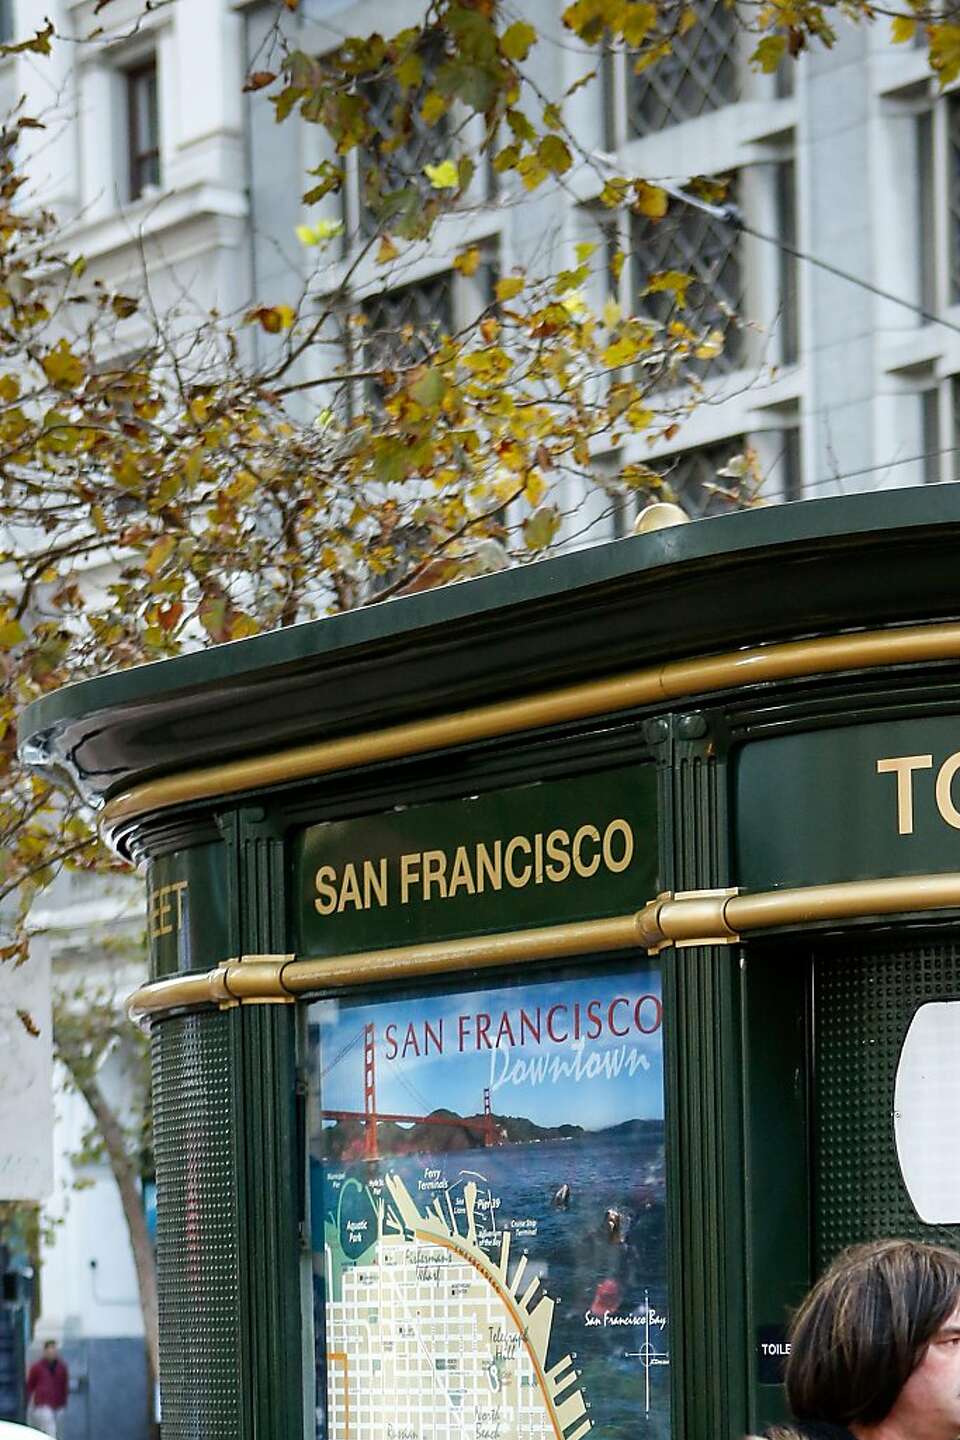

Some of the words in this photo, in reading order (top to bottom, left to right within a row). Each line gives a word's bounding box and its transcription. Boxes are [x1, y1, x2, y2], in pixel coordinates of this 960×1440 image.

[314, 858, 388, 915] SAN
[401, 819, 634, 904] FRANCISCO
[385, 1018, 443, 1060] SAN
[458, 995, 664, 1053] FRANCISCO
[489, 1036, 650, 1092] Downtown
[424, 1168, 441, 1180] Ferry
[418, 1180, 449, 1191] Terminals
[346, 1220, 369, 1233] Aquatic
[349, 1232, 362, 1243] Park
[585, 1310, 601, 1327] San
[603, 1309, 646, 1328] Francisco
[648, 1309, 667, 1331] Bay
